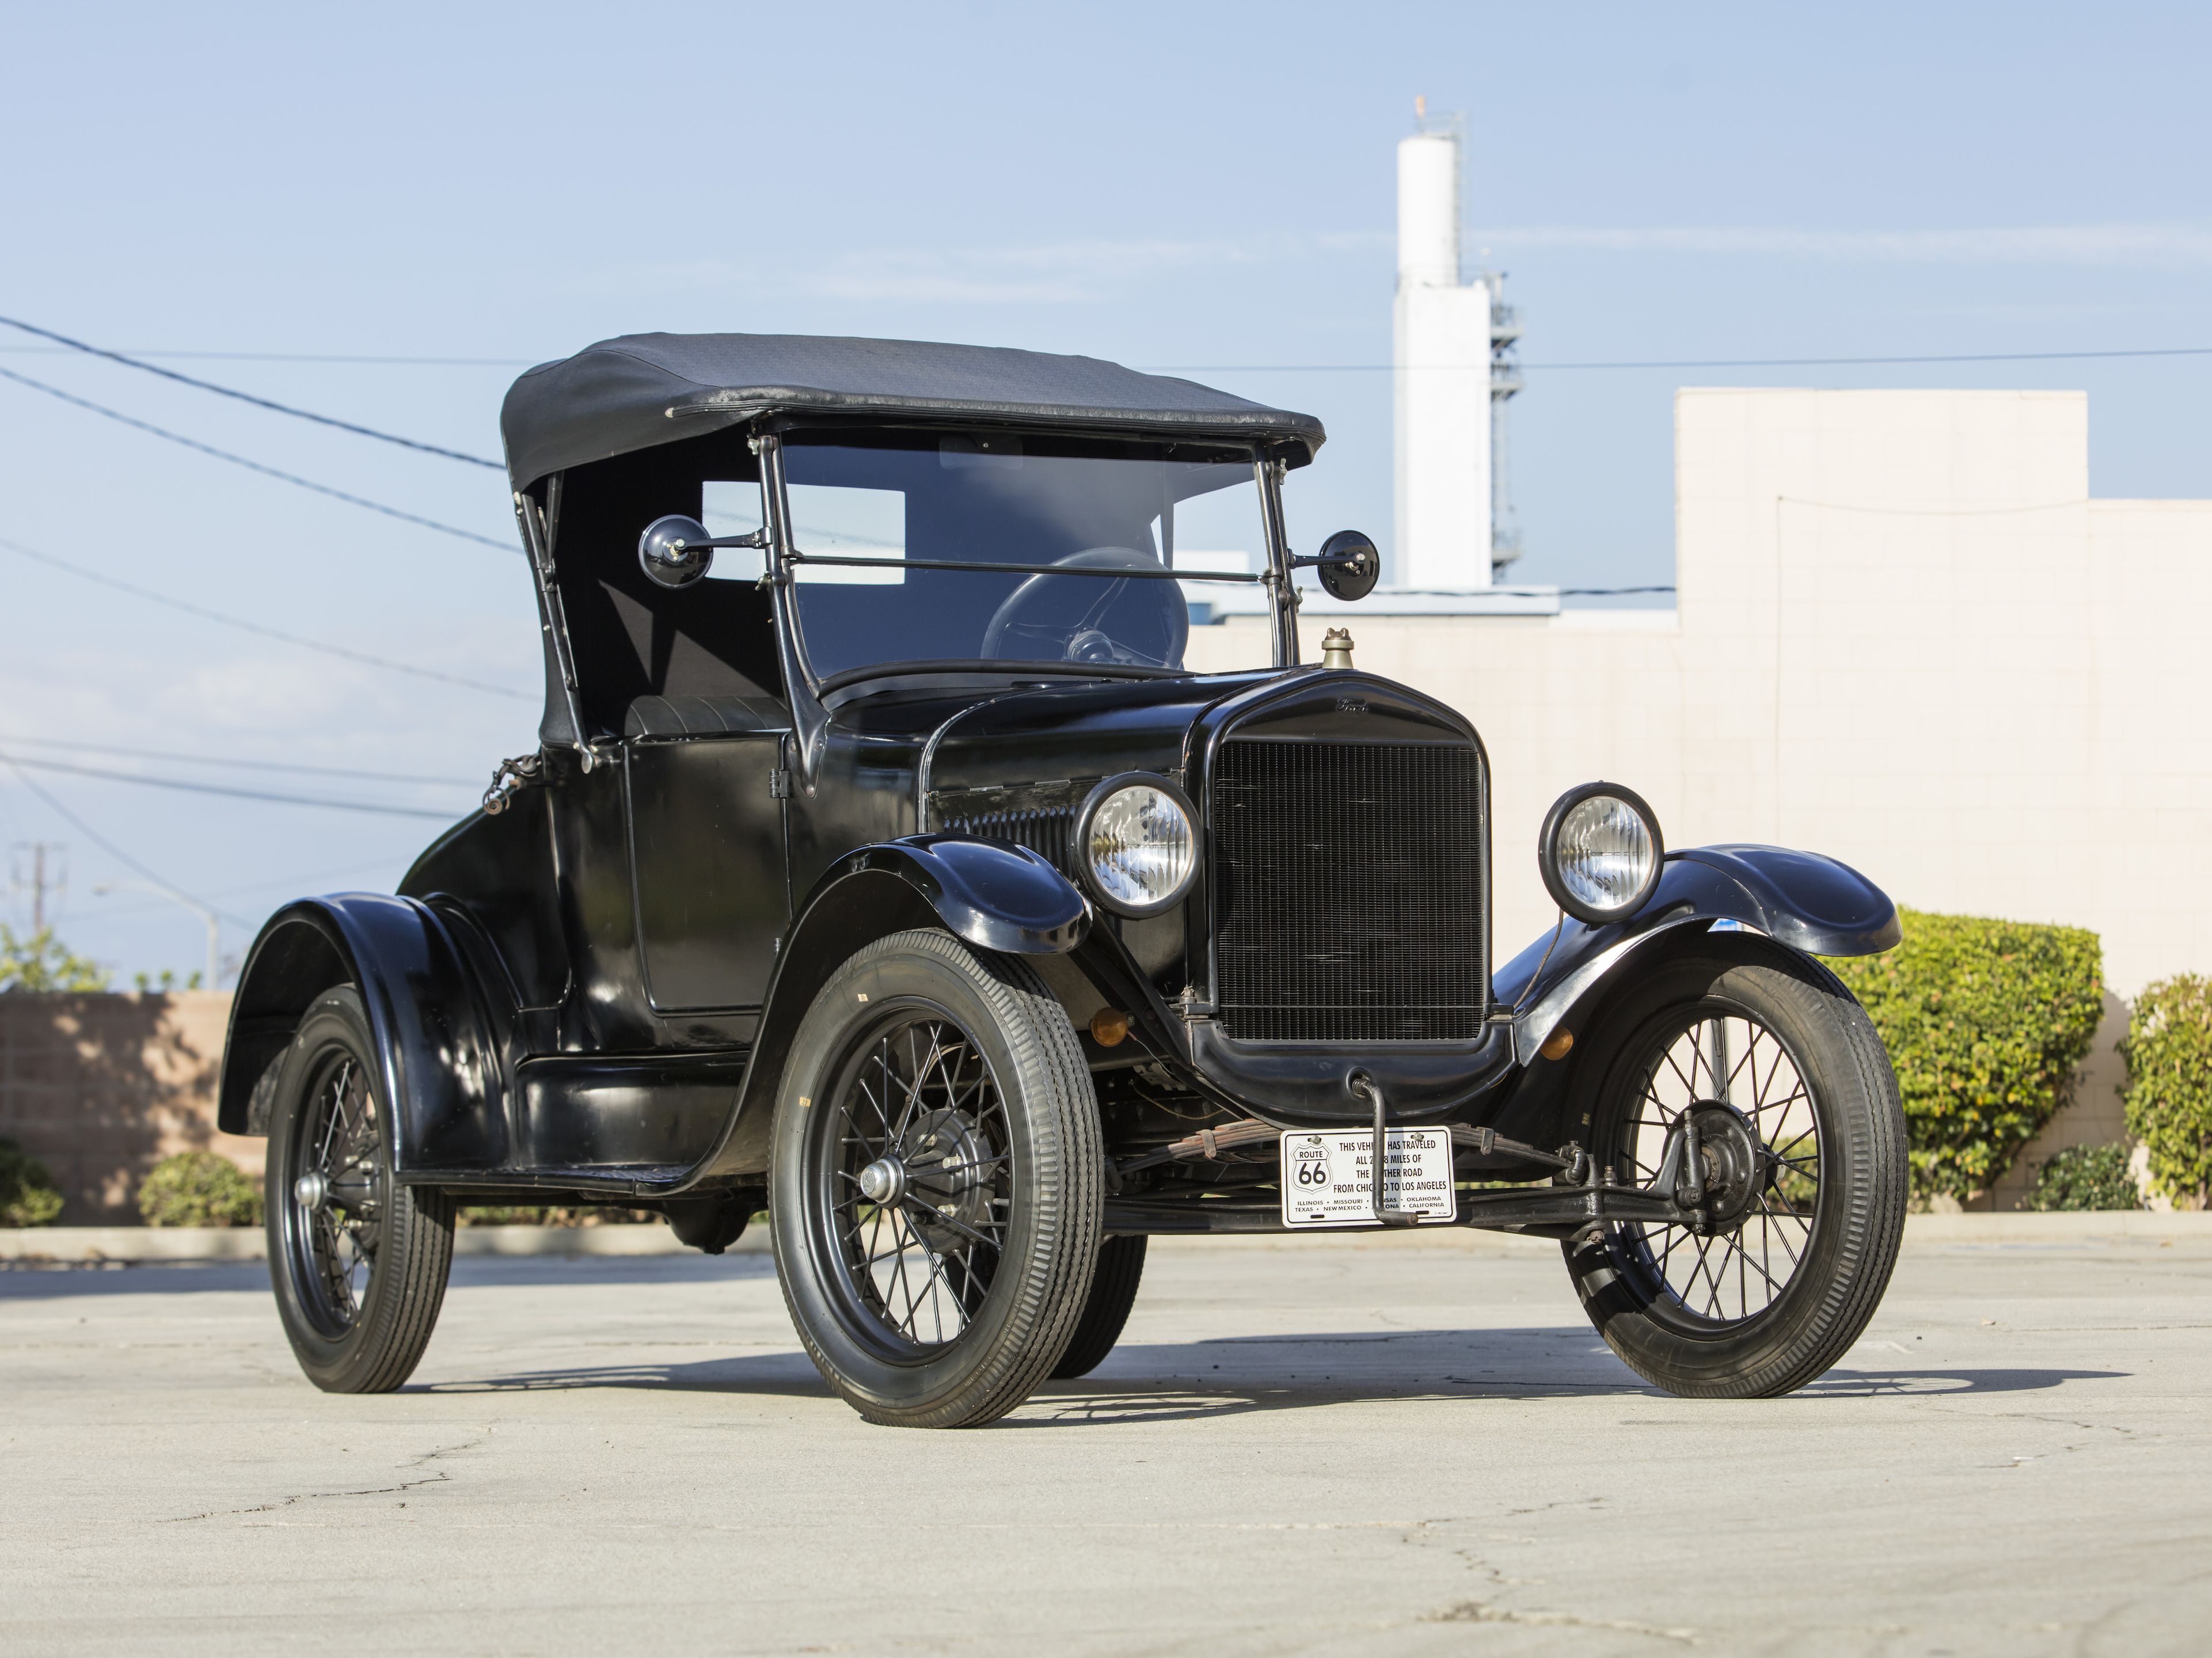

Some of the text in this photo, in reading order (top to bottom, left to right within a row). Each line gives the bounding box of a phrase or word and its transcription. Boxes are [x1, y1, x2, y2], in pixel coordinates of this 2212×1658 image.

[1336, 696, 1369, 712] Ford
[980, 991, 1006, 1029] COMMANDER
[1339, 1140, 1435, 1151] THIS VEHI HAS TRAVELED
[1356, 1154, 1422, 1165] ALL 28 MILES OF
[1299, 1162, 1326, 1185] 66
[1356, 1168, 1422, 1178] THE THER ROAD
[1333, 1181, 1446, 1193] FROM CHICO TO LOS ANGELES
